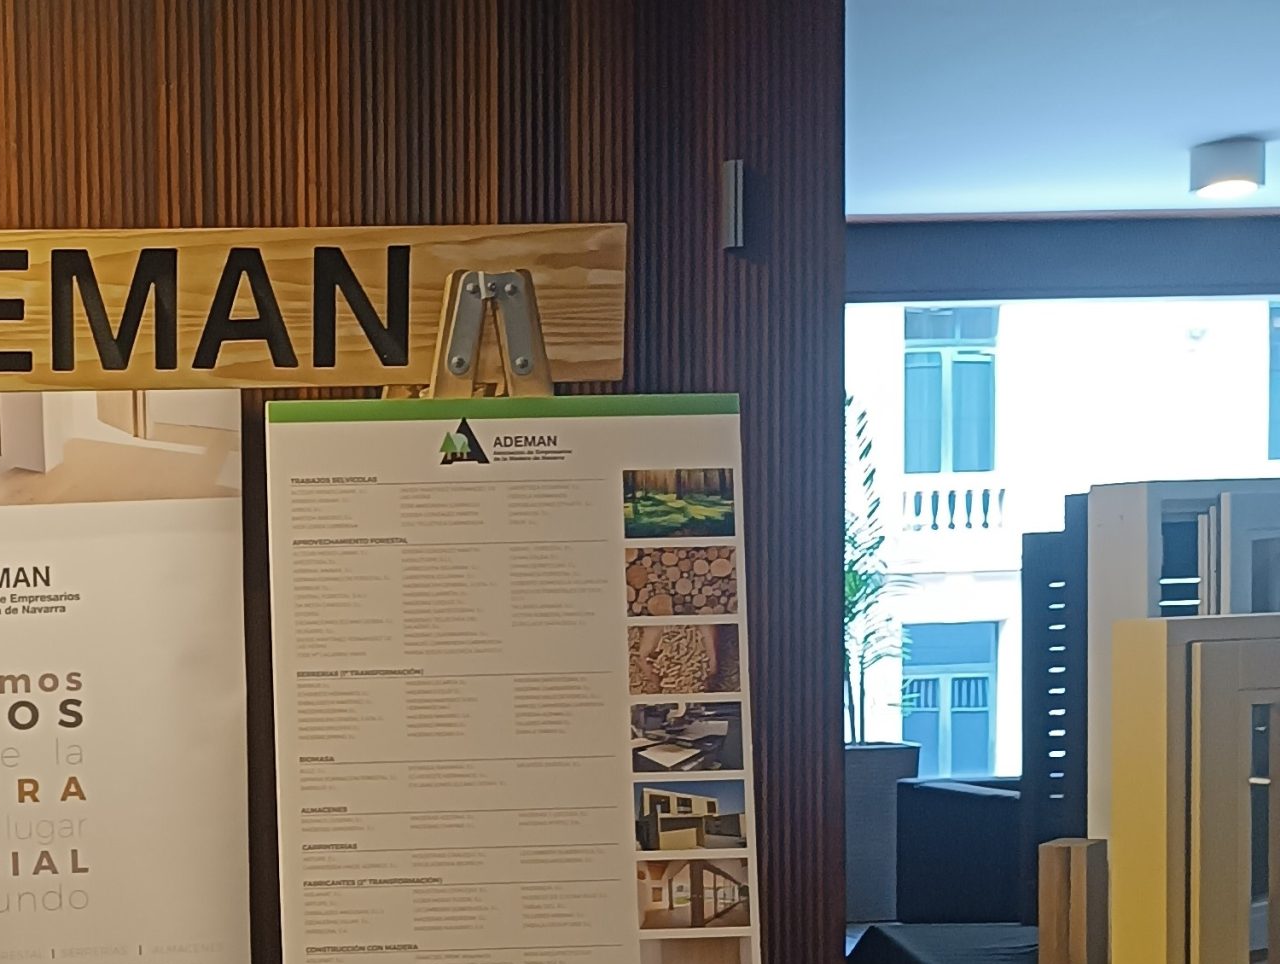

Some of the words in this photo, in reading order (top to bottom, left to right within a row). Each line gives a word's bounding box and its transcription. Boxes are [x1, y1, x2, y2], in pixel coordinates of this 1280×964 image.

[493, 436, 557, 447] ADEMAN
[10, 592, 80, 604] Empresarios
[5, 606, 18, 615] de
[22, 605, 66, 614] Navarra
[56, 737, 83, 765] la
[6, 814, 86, 845] lugar
